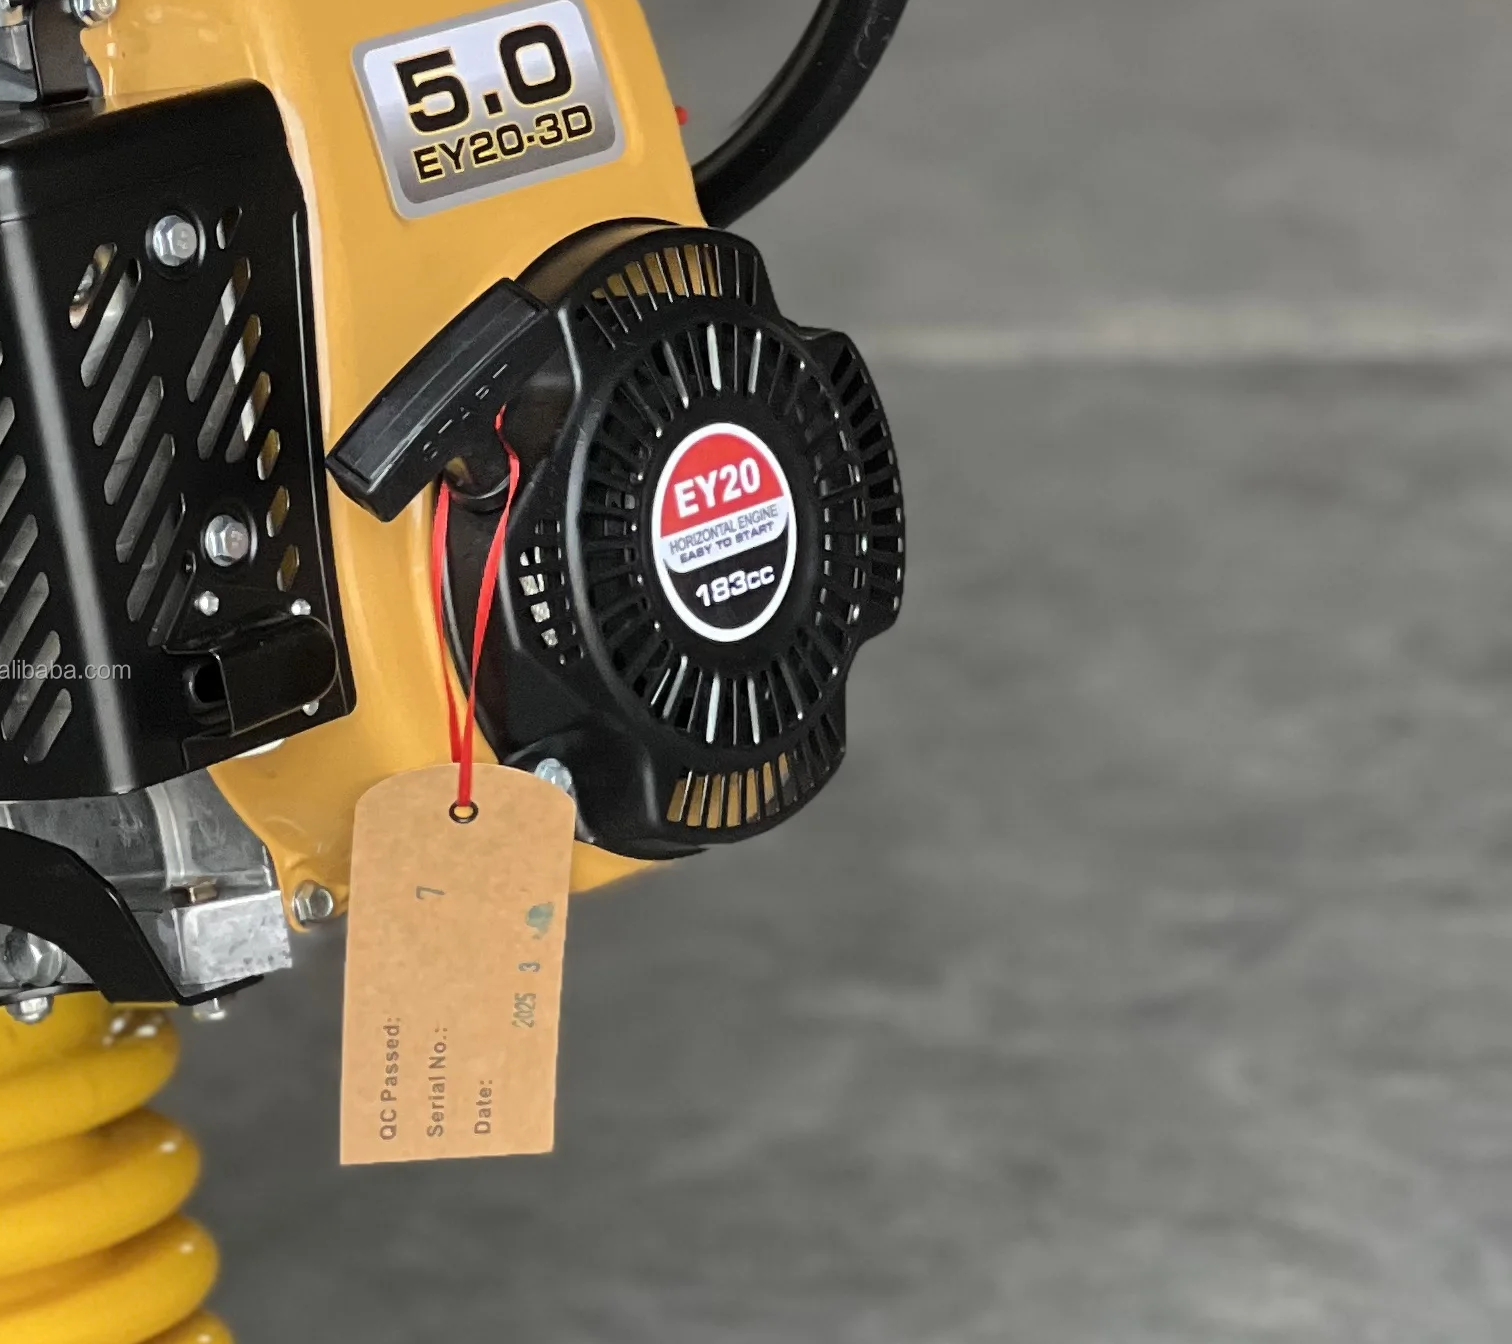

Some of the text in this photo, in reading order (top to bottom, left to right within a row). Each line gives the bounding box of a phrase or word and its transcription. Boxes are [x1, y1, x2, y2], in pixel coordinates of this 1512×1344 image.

[394, 23, 573, 134] 5.0
[411, 104, 595, 182] EY20-3D
[674, 456, 761, 519] EY20
[669, 504, 779, 555] HORIZONTAL ENGINE
[715, 536, 733, 552] TO
[735, 521, 775, 543] START
[695, 565, 776, 607] 183cc
[511, 961, 541, 1028] 2025 3
[379, 1016, 401, 1141] QC Passed:
[426, 1076, 446, 1137] Serial
[473, 1079, 493, 1134] Date:
